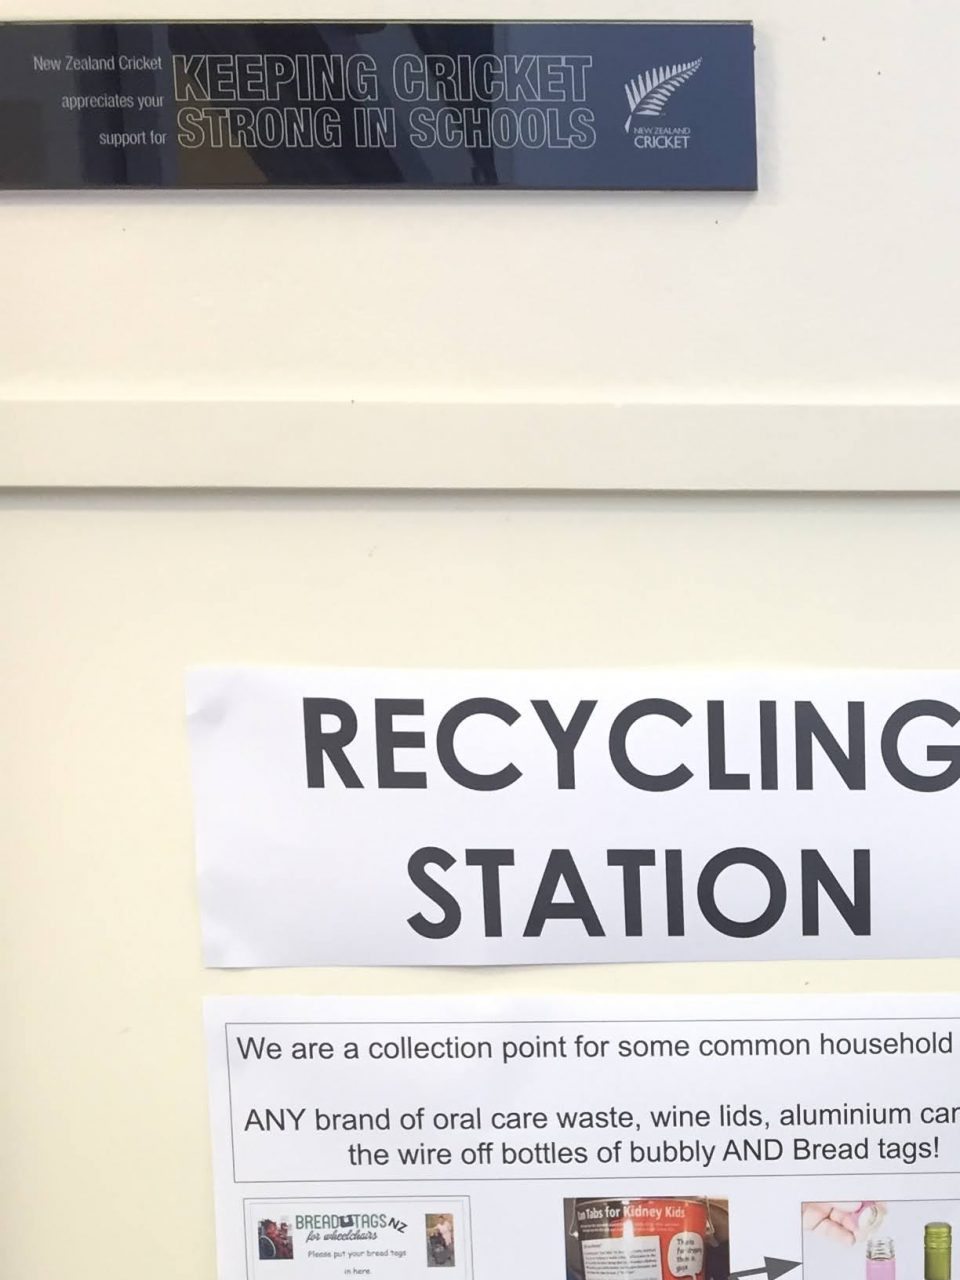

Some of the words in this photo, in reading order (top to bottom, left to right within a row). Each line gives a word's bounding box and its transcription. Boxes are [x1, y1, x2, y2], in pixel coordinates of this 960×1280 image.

[33, 56, 61, 71] New
[65, 55, 115, 71] Zealand
[119, 55, 163, 71] Cricket
[173, 54, 378, 102] KEEPING
[393, 54, 592, 102] CRICKET
[61, 93, 134, 112] appreciates
[137, 95, 165, 110] your
[177, 107, 341, 149] STRONG
[354, 107, 397, 148] IN
[409, 107, 597, 149] SCHOOLS
[633, 126, 653, 135] NEW
[654, 126, 691, 135] ZEALAND
[99, 130, 147, 148] support
[150, 130, 168, 146] for
[633, 136, 690, 149] CRICKET
[406, 845, 872, 940] STATION
[236, 1036, 282, 1060] We
[291, 1042, 334, 1060] are
[343, 1042, 360, 1060] a
[368, 1033, 491, 1060] collection
[502, 1033, 567, 1065] point
[574, 1032, 610, 1057] for
[618, 1039, 690, 1057] some
[699, 1038, 811, 1057] common
[819, 1030, 953, 1055] household
[244, 1108, 306, 1132] ANY
[315, 1107, 390, 1131] brand
[400, 1106, 425, 1131] of
[432, 1106, 481, 1131] oral
[490, 1112, 549, 1130] care
[556, 1107, 641, 1132] waste,
[650, 1104, 711, 1128] wine
[720, 1103, 770, 1131] lids,
[780, 1101, 912, 1127] aluminium
[348, 1142, 389, 1166] the
[397, 1142, 452, 1166] wire
[460, 1141, 495, 1165] off
[501, 1140, 589, 1165] bottles
[597, 1139, 624, 1163] of
[629, 1139, 716, 1167] bubbly
[722, 1138, 784, 1162] AND
[794, 1136, 869, 1161] Bread
[877, 1136, 940, 1165] tags!
[605, 1206, 620, 1218] for
[623, 1206, 662, 1220] Kidney
[665, 1206, 686, 1218] Kids
[295, 1215, 341, 1230] BREAD
[352, 1214, 388, 1229] TAGS
[388, 1217, 408, 1234] NZ
[306, 1230, 320, 1243] for
[323, 1229, 378, 1242] wheelchairs
[308, 1250, 332, 1258] Please
[333, 1250, 346, 1259] put
[348, 1251, 365, 1259] your
